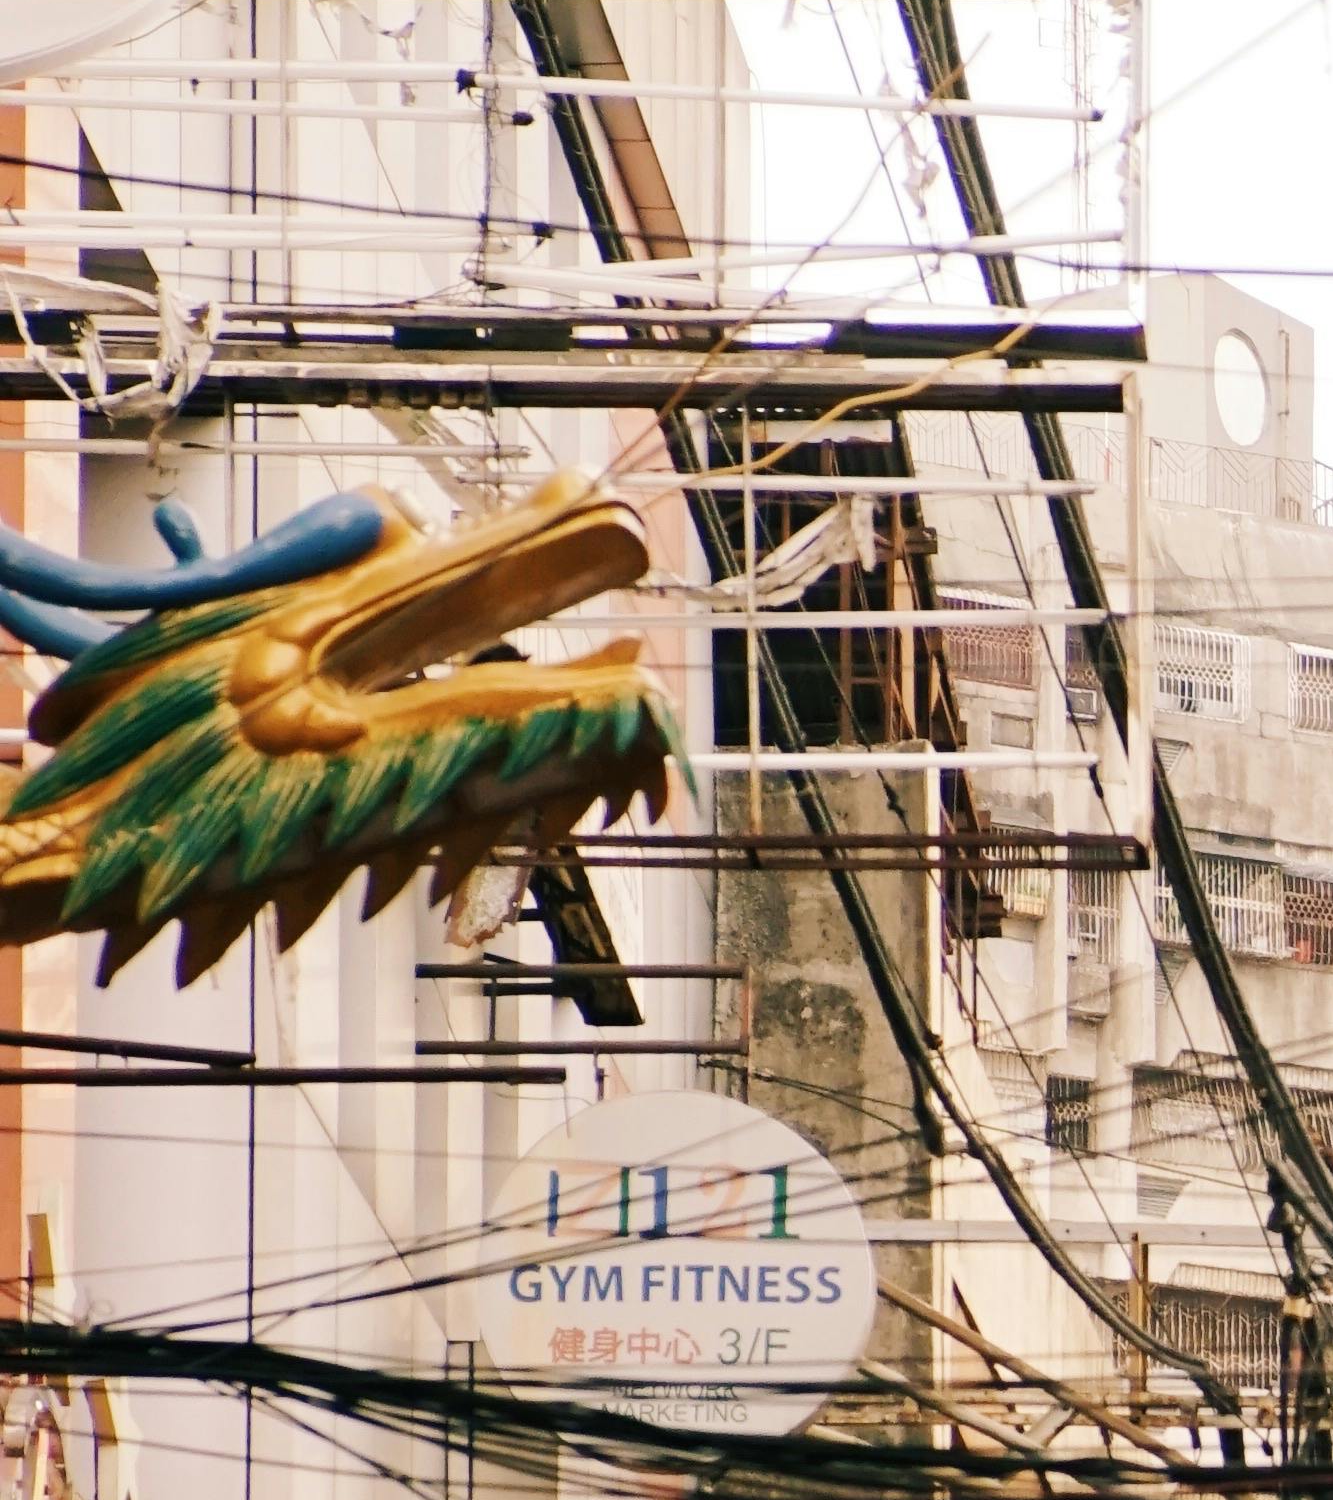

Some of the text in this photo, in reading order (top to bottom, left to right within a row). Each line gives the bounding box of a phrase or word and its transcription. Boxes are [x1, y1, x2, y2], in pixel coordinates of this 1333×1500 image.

[509, 1265, 842, 1303] GYM FITNESS
[547, 1326, 791, 1366] 健身中心 3/F
[600, 1401, 748, 1424] MARKETING
